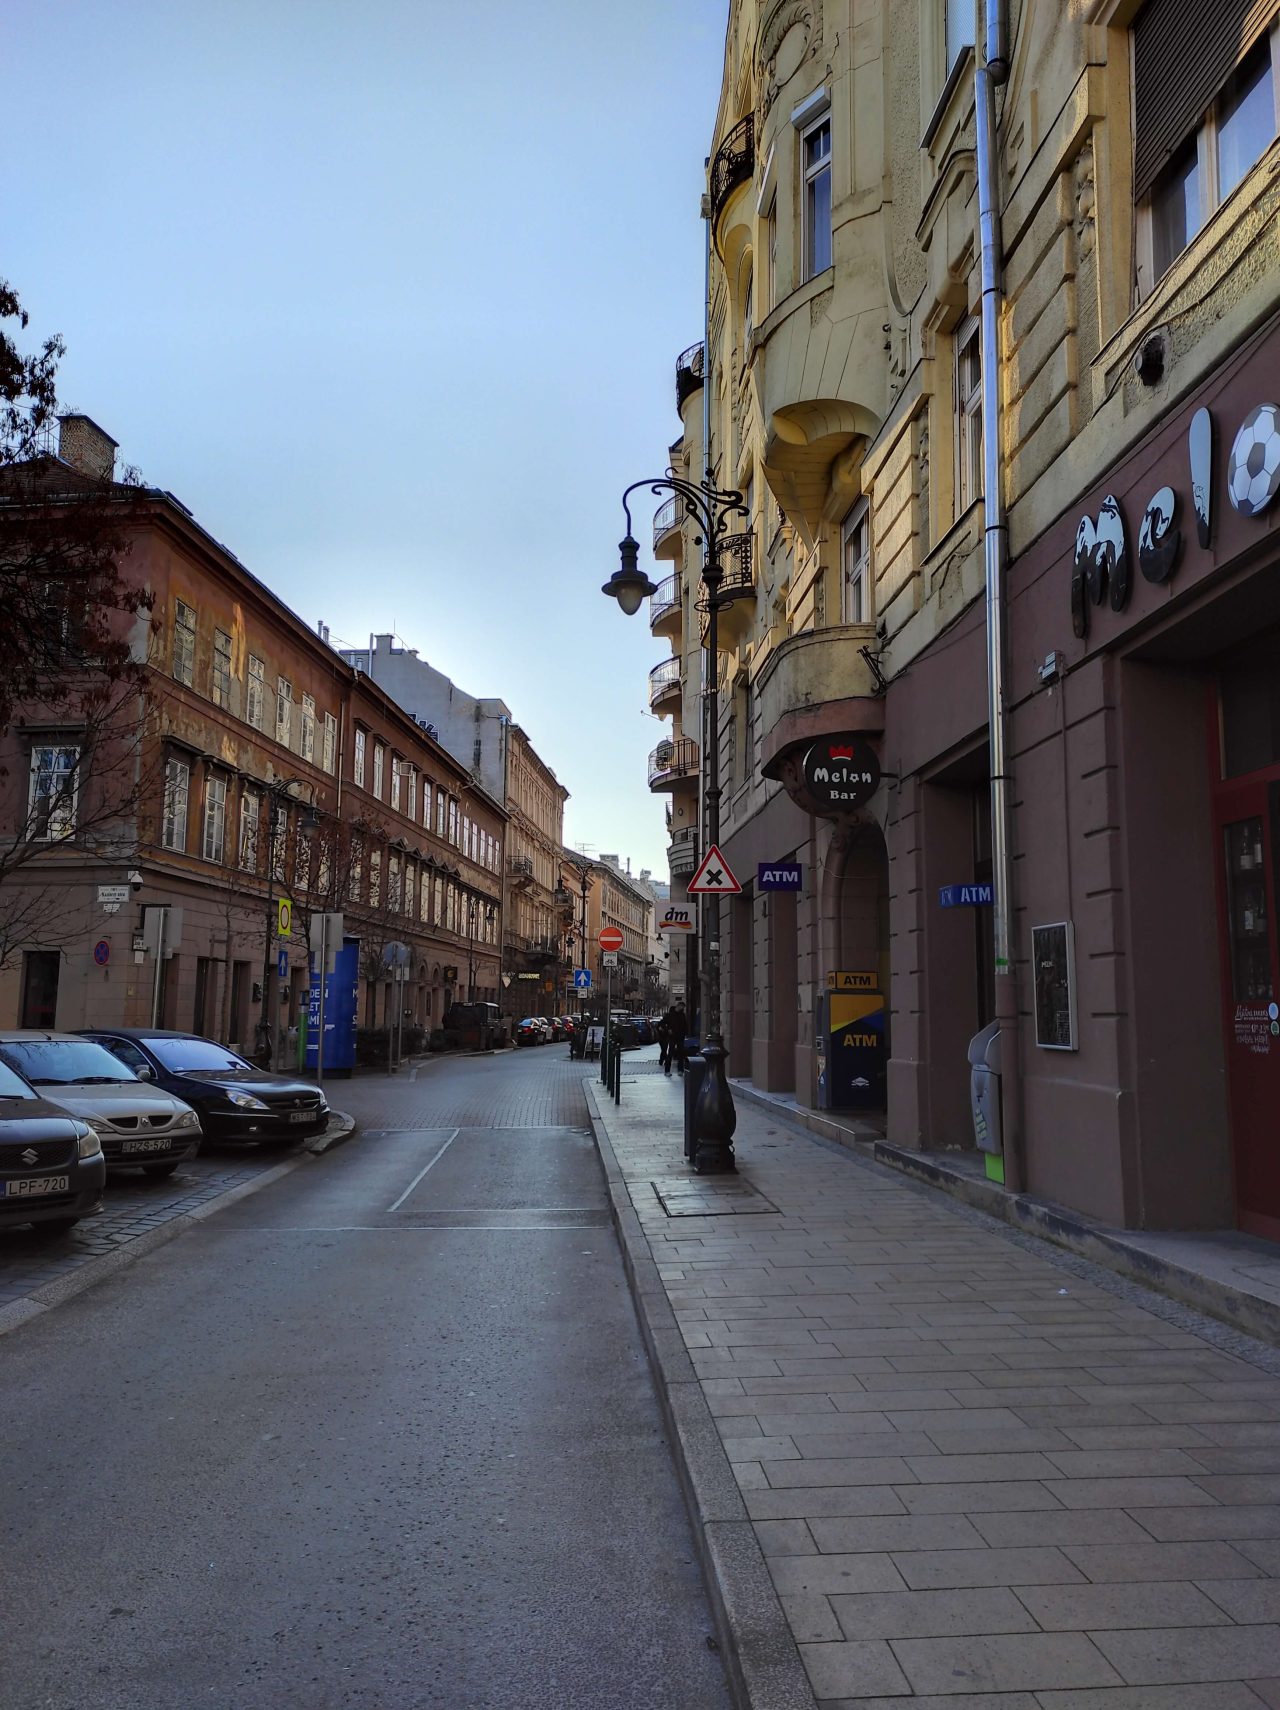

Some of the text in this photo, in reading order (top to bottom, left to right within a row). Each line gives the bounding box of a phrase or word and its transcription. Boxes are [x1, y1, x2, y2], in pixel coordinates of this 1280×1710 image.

[830, 789, 857, 800] Bar
[762, 871, 798, 882] ATM
[961, 886, 991, 902] ATM
[664, 907, 689, 922] dm
[843, 975, 871, 986] ATM
[843, 1034, 877, 1047] ATM
[129, 1139, 172, 1151] HZS-520
[8, 1177, 67, 1196] LPF-720
